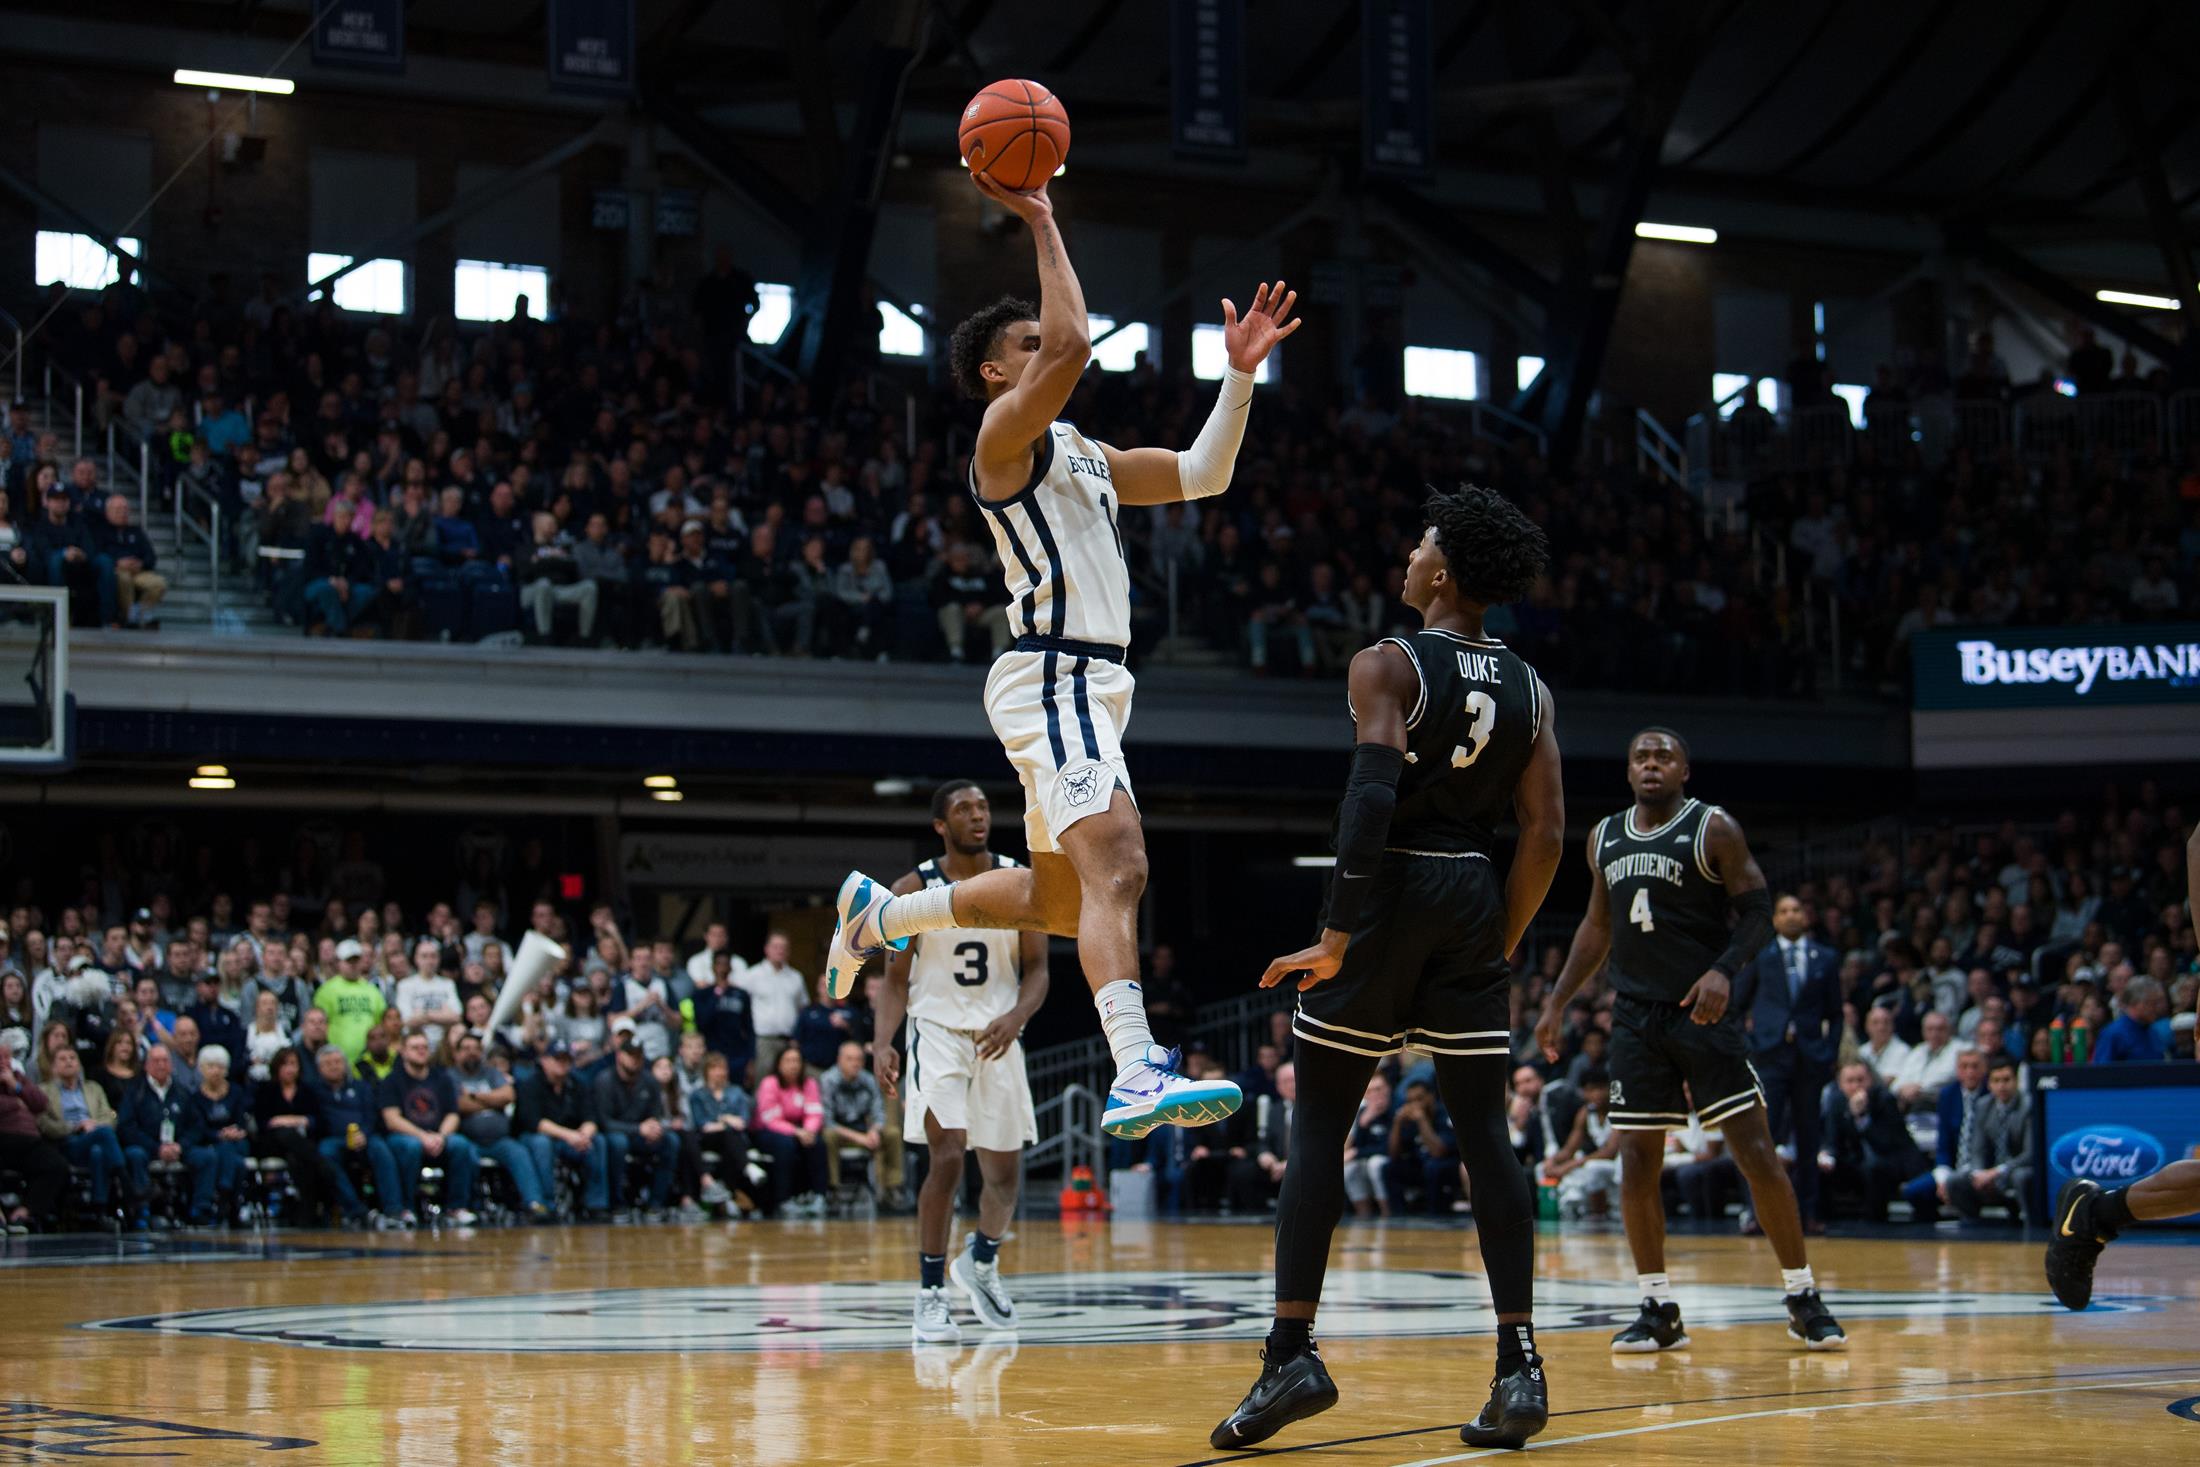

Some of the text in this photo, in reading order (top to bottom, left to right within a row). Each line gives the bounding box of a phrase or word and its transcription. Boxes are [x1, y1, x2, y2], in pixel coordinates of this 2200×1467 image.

[1100, 492, 1122, 559] 1
[1456, 650, 1502, 684] DUKE
[1450, 690, 1497, 769] 3
[1604, 852, 1684, 891] PROVIDENCE
[1629, 888, 1656, 933] 4
[954, 941, 988, 987] 3
[2070, 1133, 2142, 1177] Ford
